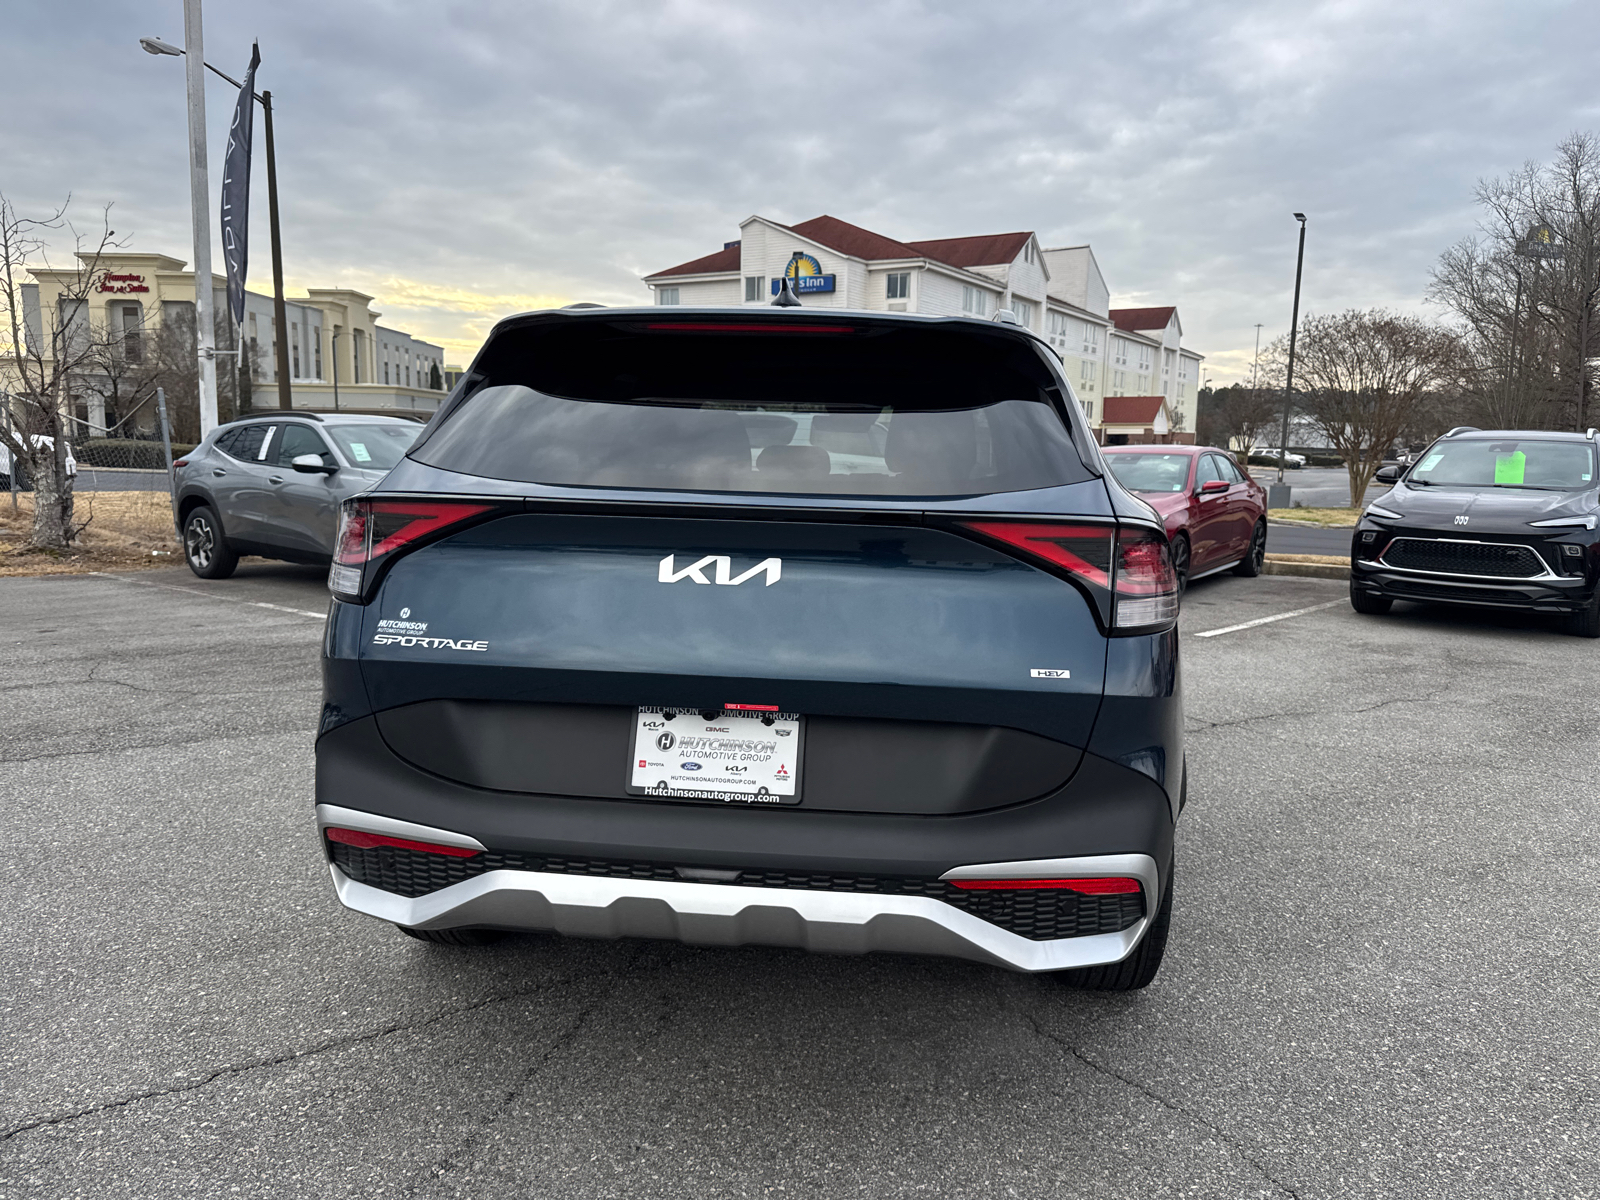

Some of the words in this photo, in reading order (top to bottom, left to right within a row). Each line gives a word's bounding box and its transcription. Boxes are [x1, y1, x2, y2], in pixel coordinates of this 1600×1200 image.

[98, 272, 145, 283] Hampton
[806, 278, 824, 287] Inn
[95, 283, 119, 293] Inn
[125, 284, 149, 293] Suites
[658, 553, 781, 587] KIA
[377, 620, 428, 630] HUTCHINSON
[373, 635, 489, 651] SPORTAGE
[638, 705, 699, 716] HUTCHINSON
[765, 711, 800, 721] GROUP
[678, 736, 777, 754] HUTCHINSON
[679, 750, 738, 760] AUTOMOTIVE
[740, 753, 771, 762] GROUP
[671, 775, 757, 785] HUTCHINSONAUTOGROUP.COM
[645, 786, 780, 803] Hutchinsonautogroup.com
